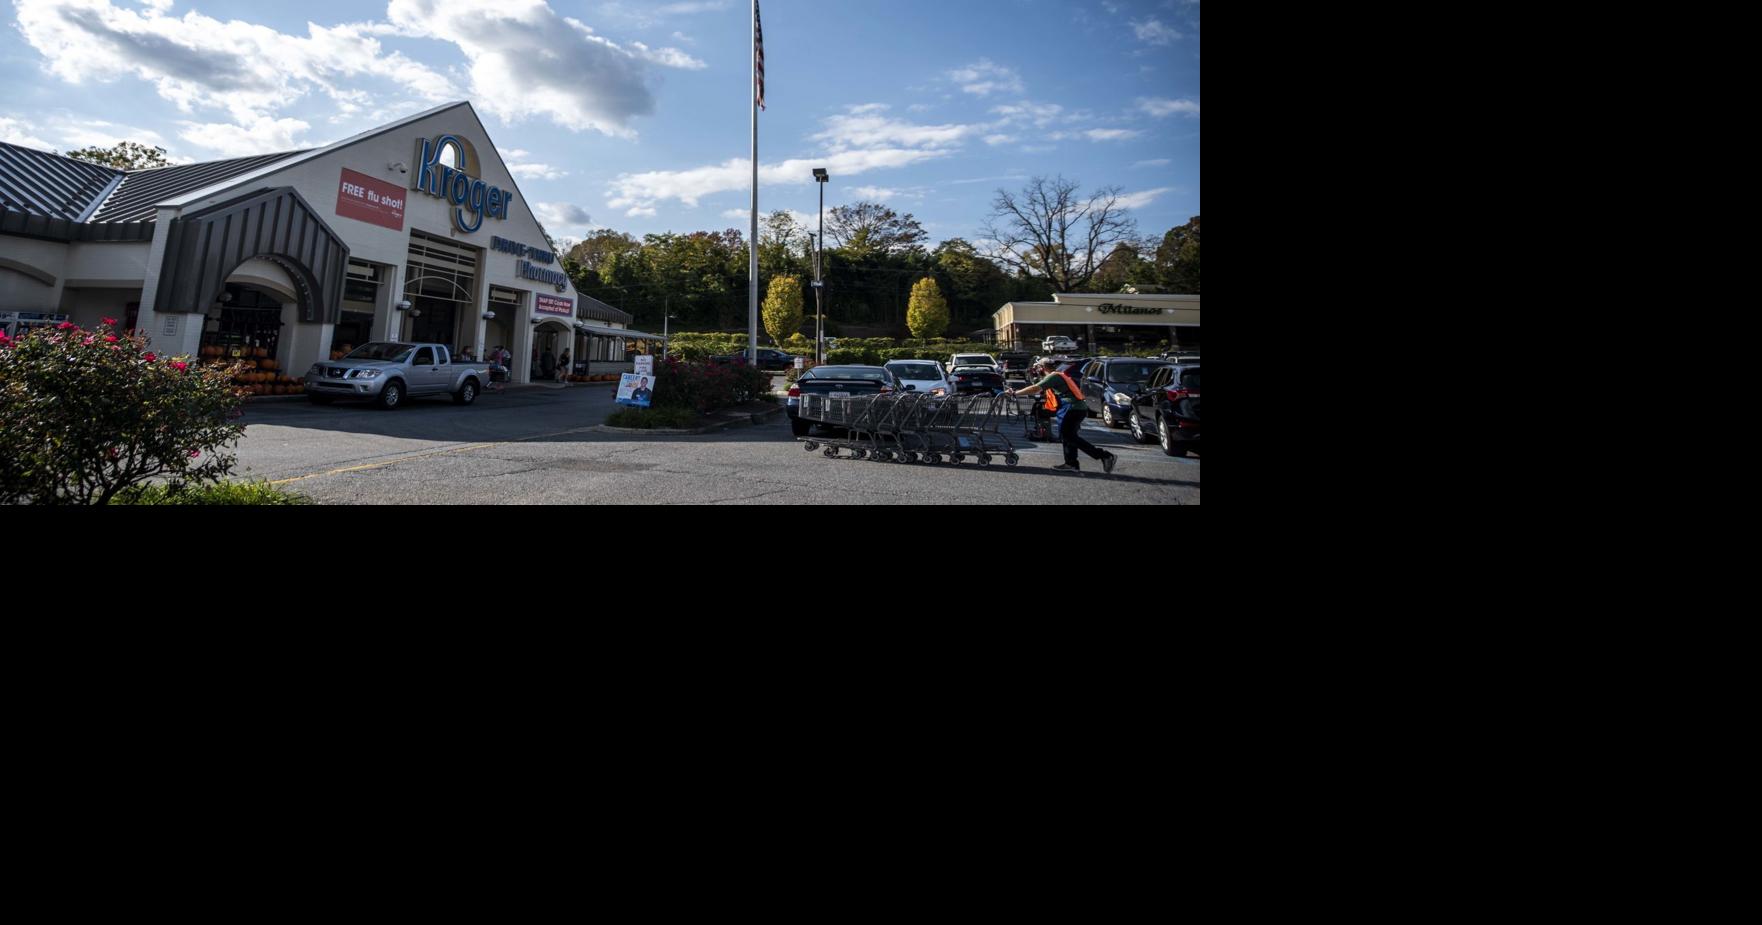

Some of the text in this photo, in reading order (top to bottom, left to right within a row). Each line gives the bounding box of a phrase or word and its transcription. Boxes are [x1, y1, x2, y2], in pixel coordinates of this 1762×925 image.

[342, 182, 365, 198] FREE
[367, 190, 379, 203] flu
[381, 196, 403, 210] shot!
[412, 134, 512, 233] Kroger
[517, 259, 568, 292] Pharmacy
[1098, 303, 1162, 315] Milanos
